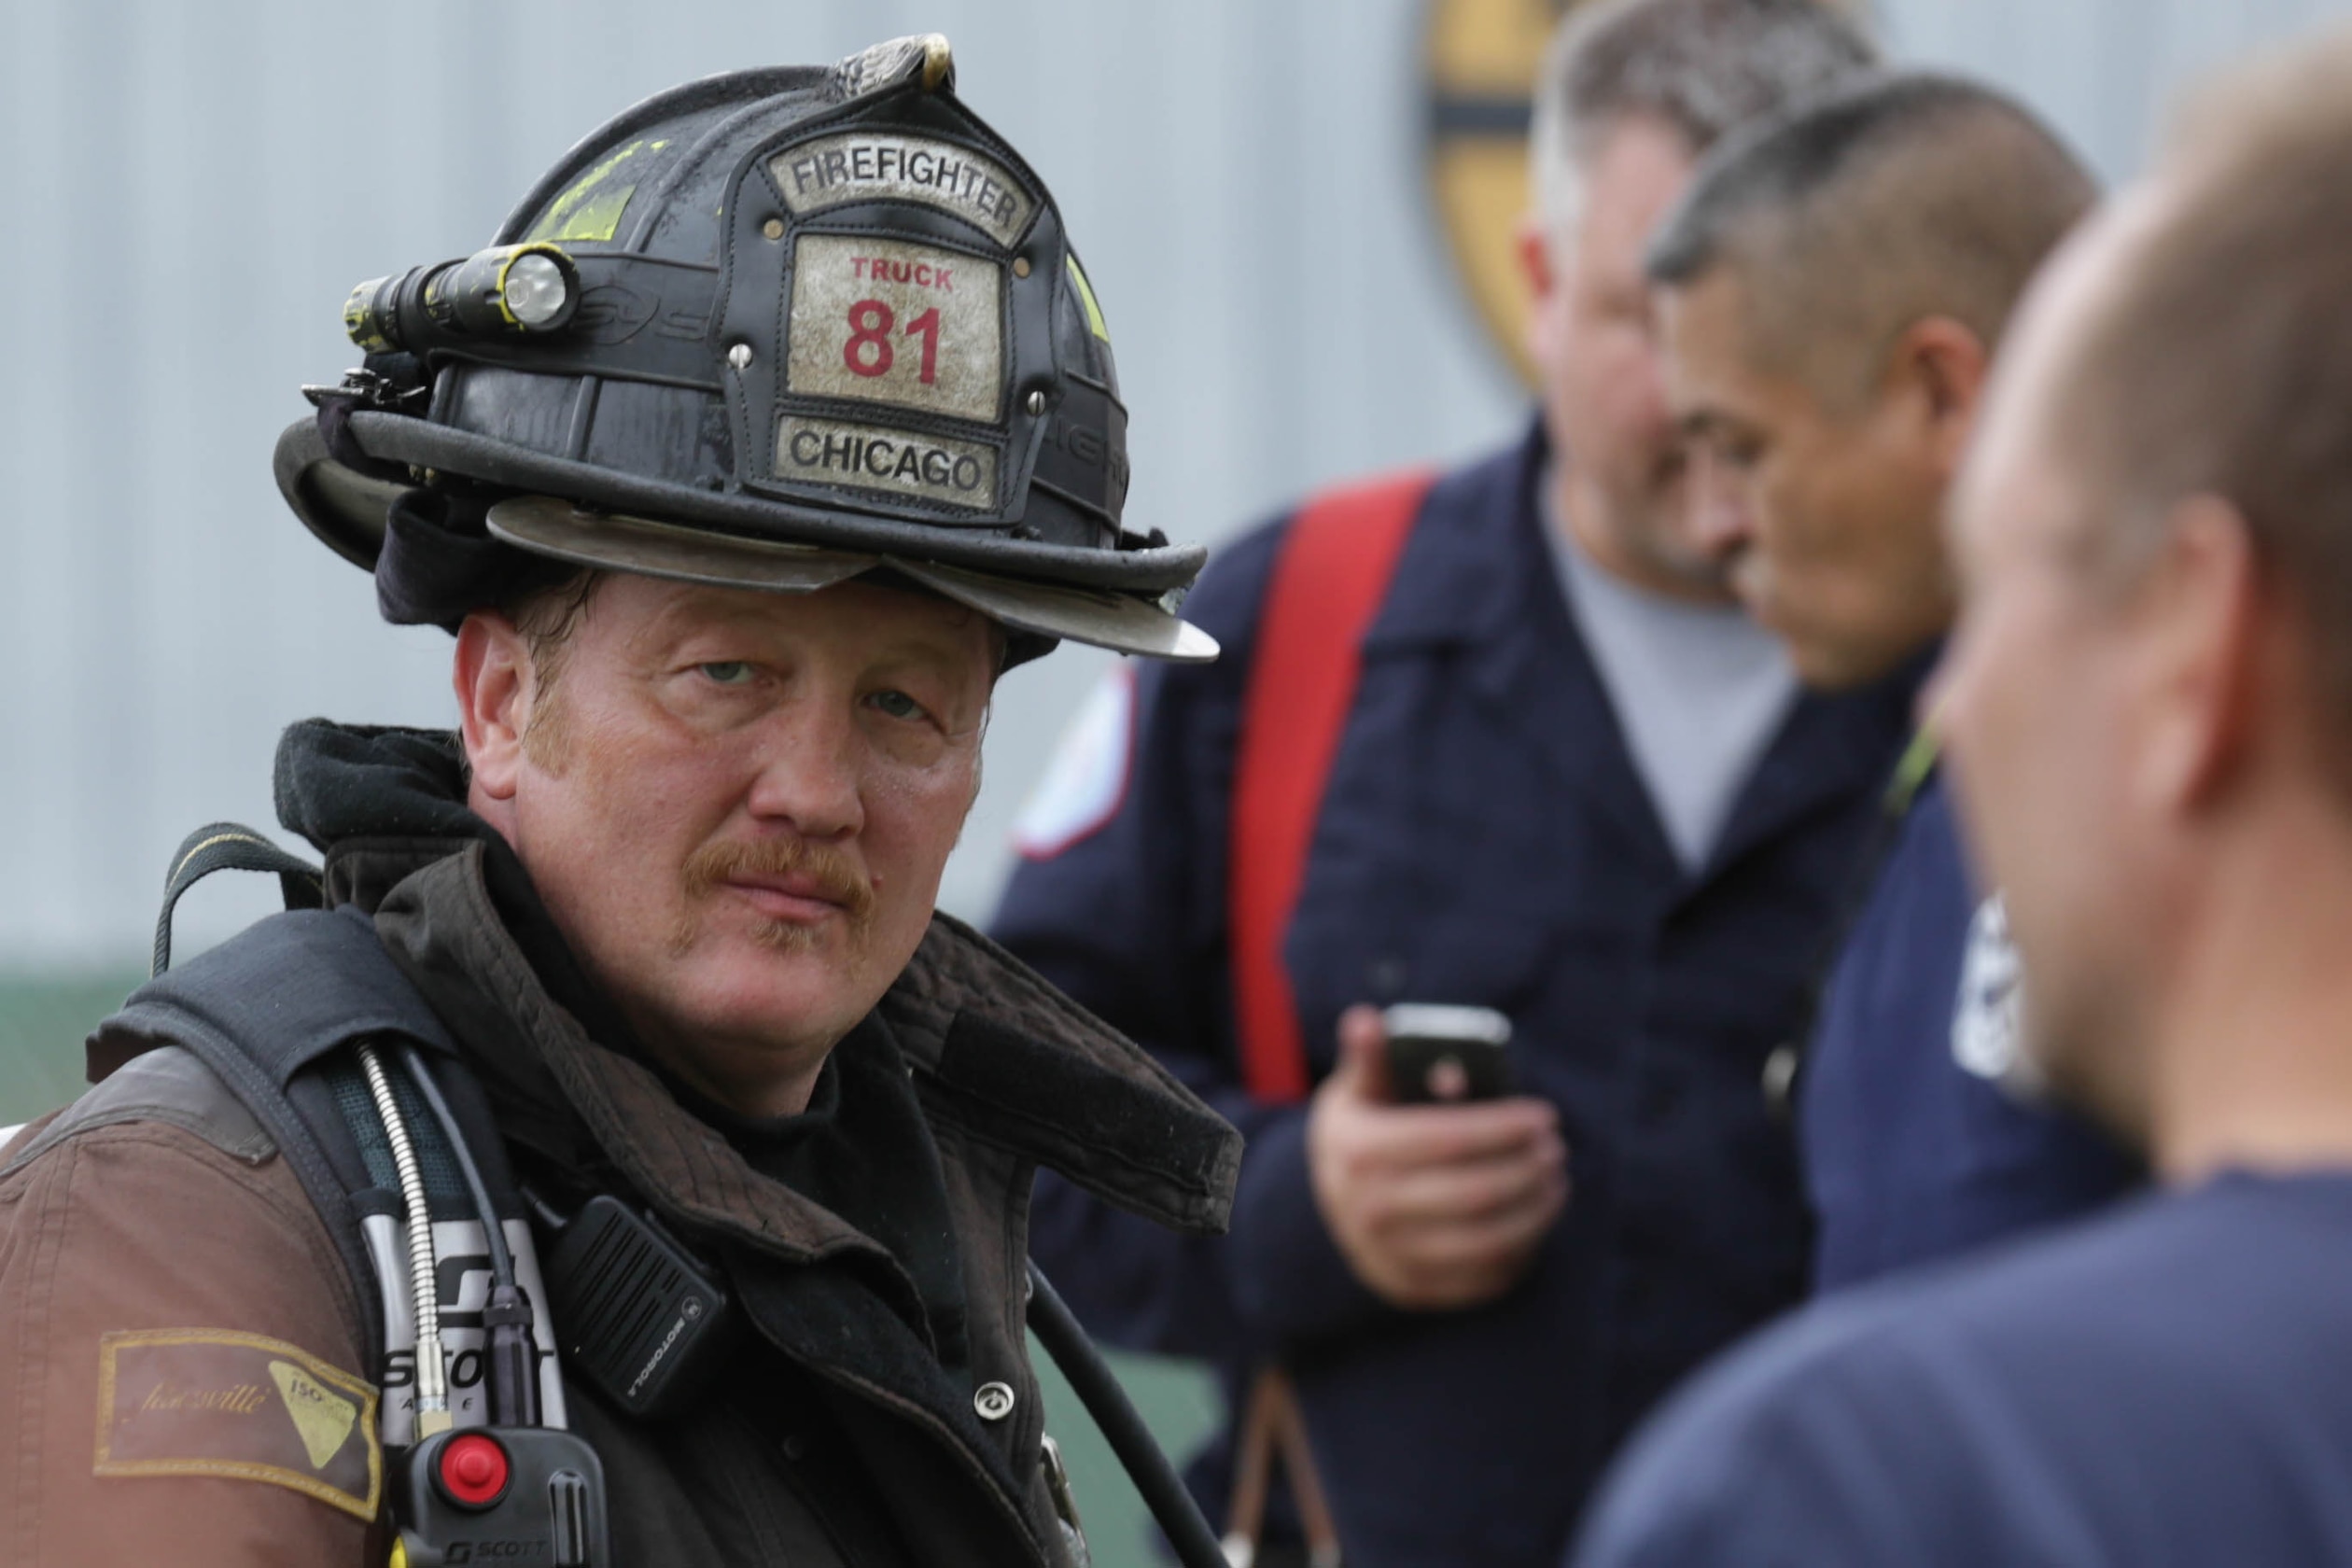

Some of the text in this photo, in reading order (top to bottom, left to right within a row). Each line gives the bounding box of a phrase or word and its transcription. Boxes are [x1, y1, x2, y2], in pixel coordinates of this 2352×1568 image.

[792, 147, 1018, 227] FIREFIGHTER
[850, 257, 954, 292] TRUCK
[843, 299, 941, 385] 81
[791, 430, 980, 491] CHICAGO
[626, 1317, 686, 1398] MOTOROLA
[476, 1540, 546, 1558] SCOTT
